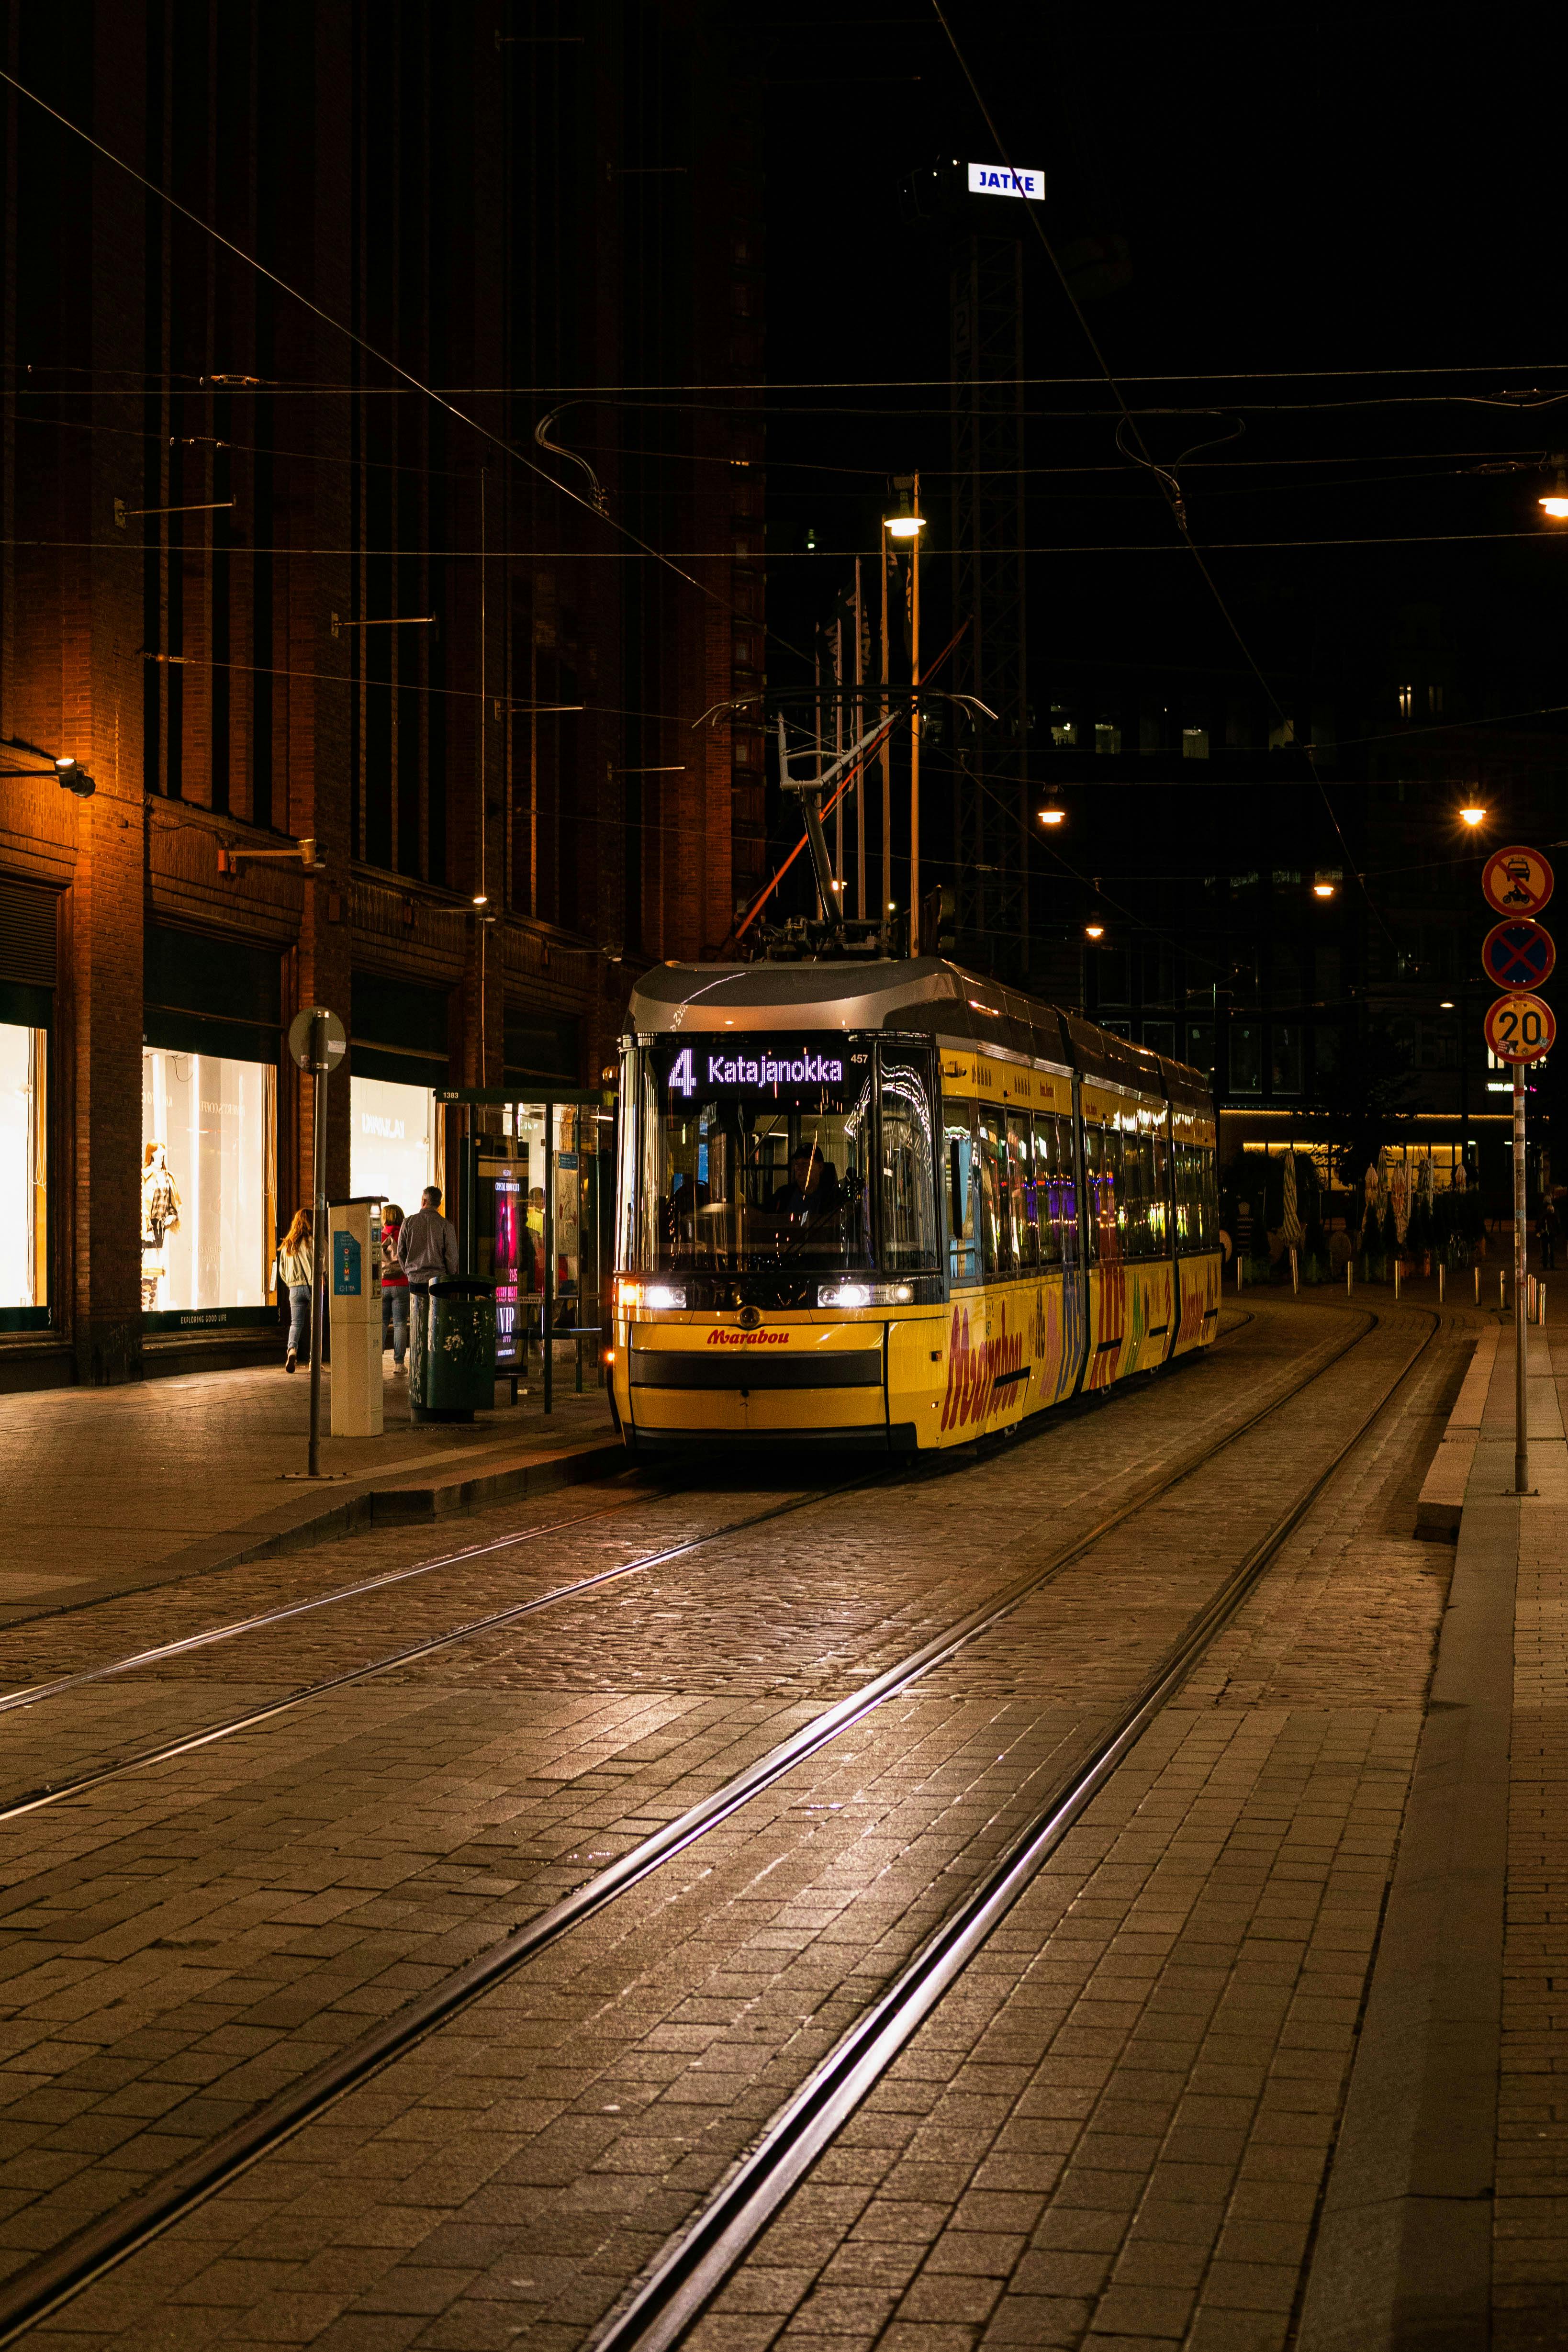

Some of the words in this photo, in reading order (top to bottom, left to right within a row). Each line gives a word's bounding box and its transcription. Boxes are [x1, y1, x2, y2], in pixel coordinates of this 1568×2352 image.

[979, 171, 1034, 191] JATKE
[1499, 1011, 1541, 1045] 20
[851, 1054, 868, 1064] 457
[668, 1048, 696, 1096] 4
[708, 1054, 842, 1087] Katajanokka
[509, 1268, 517, 1282] 21-05
[181, 1315, 204, 1324] EXPLORING
[205, 1314, 217, 1322] GOOD
[499, 1307, 514, 1333] VIP
[503, 1334, 511, 1343] area
[707, 1329, 789, 1344] Marabou
